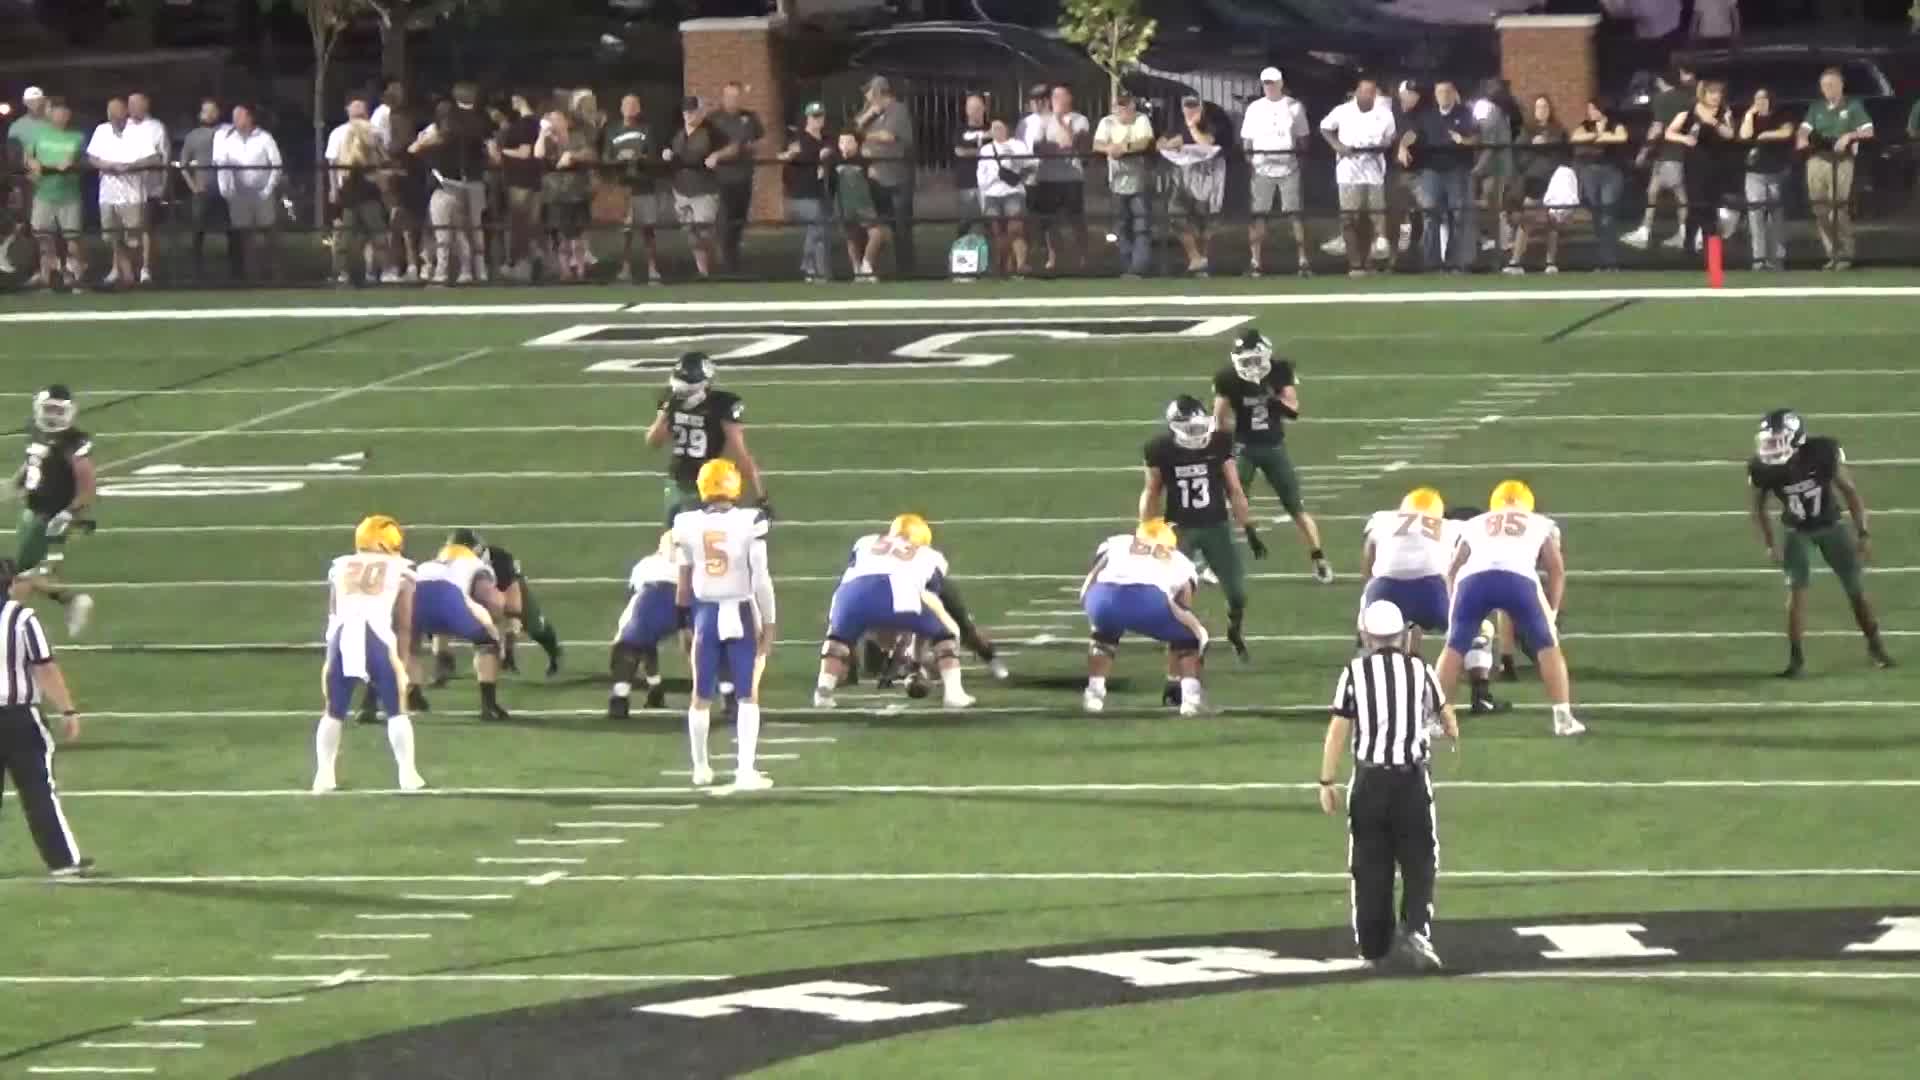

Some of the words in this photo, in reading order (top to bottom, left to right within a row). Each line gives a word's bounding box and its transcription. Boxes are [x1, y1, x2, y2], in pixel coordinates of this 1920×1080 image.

[672, 423, 708, 458] 29
[1177, 477, 1211, 509] 13
[1787, 486, 1822, 520] 47
[1393, 513, 1442, 542] 79
[703, 530, 729, 577] 5
[346, 560, 388, 596] 20
